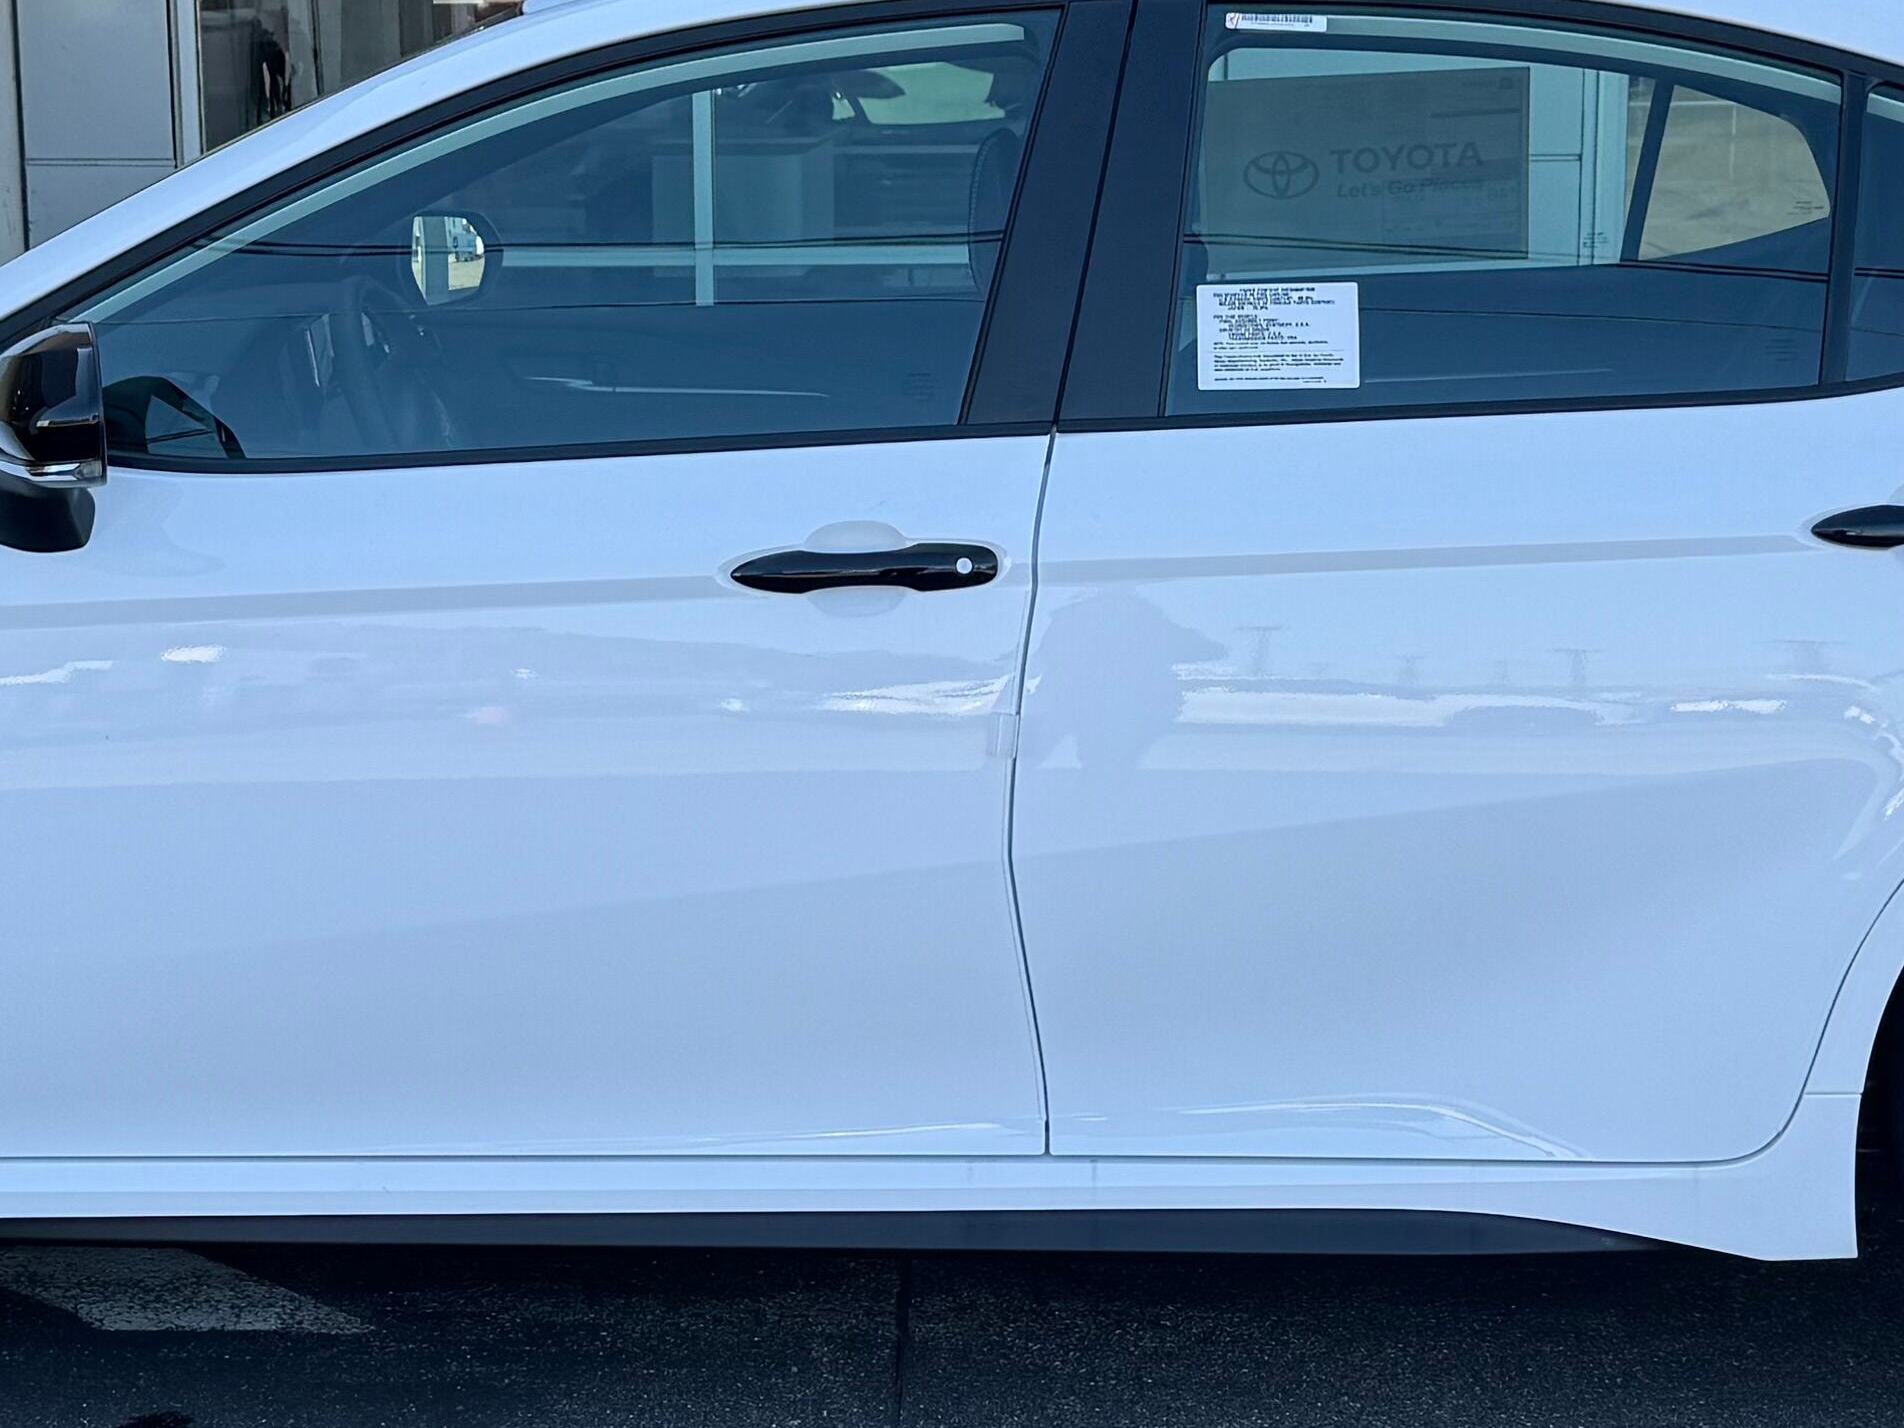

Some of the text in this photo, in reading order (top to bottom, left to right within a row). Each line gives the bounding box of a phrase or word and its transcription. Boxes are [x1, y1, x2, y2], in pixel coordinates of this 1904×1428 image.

[1329, 141, 1484, 173] TOYOTA
[1336, 182, 1382, 197] Let's
[1387, 180, 1415, 195] Go
